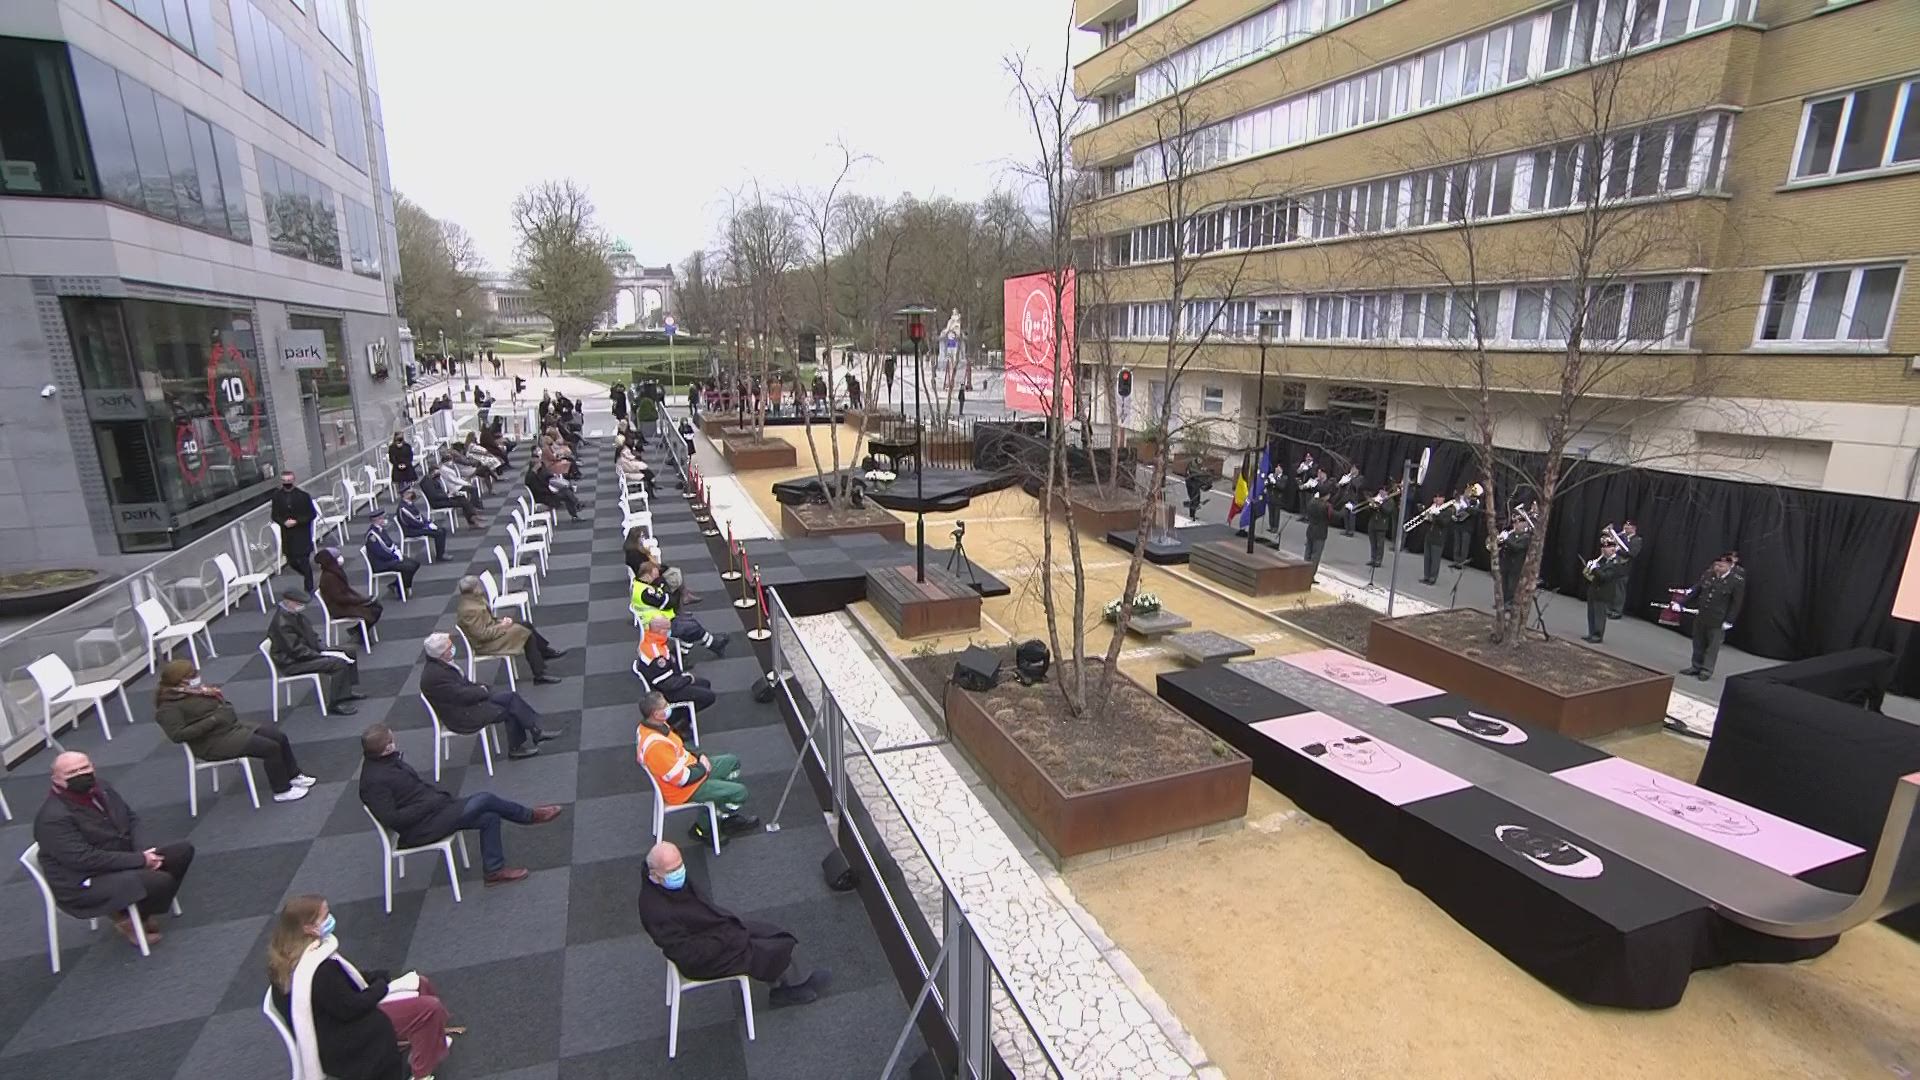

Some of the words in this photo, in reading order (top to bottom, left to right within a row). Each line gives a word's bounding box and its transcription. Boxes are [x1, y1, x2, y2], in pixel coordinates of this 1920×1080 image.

[284, 345, 321, 360] park
[221, 377, 245, 402] 10
[121, 507, 162, 523] park
